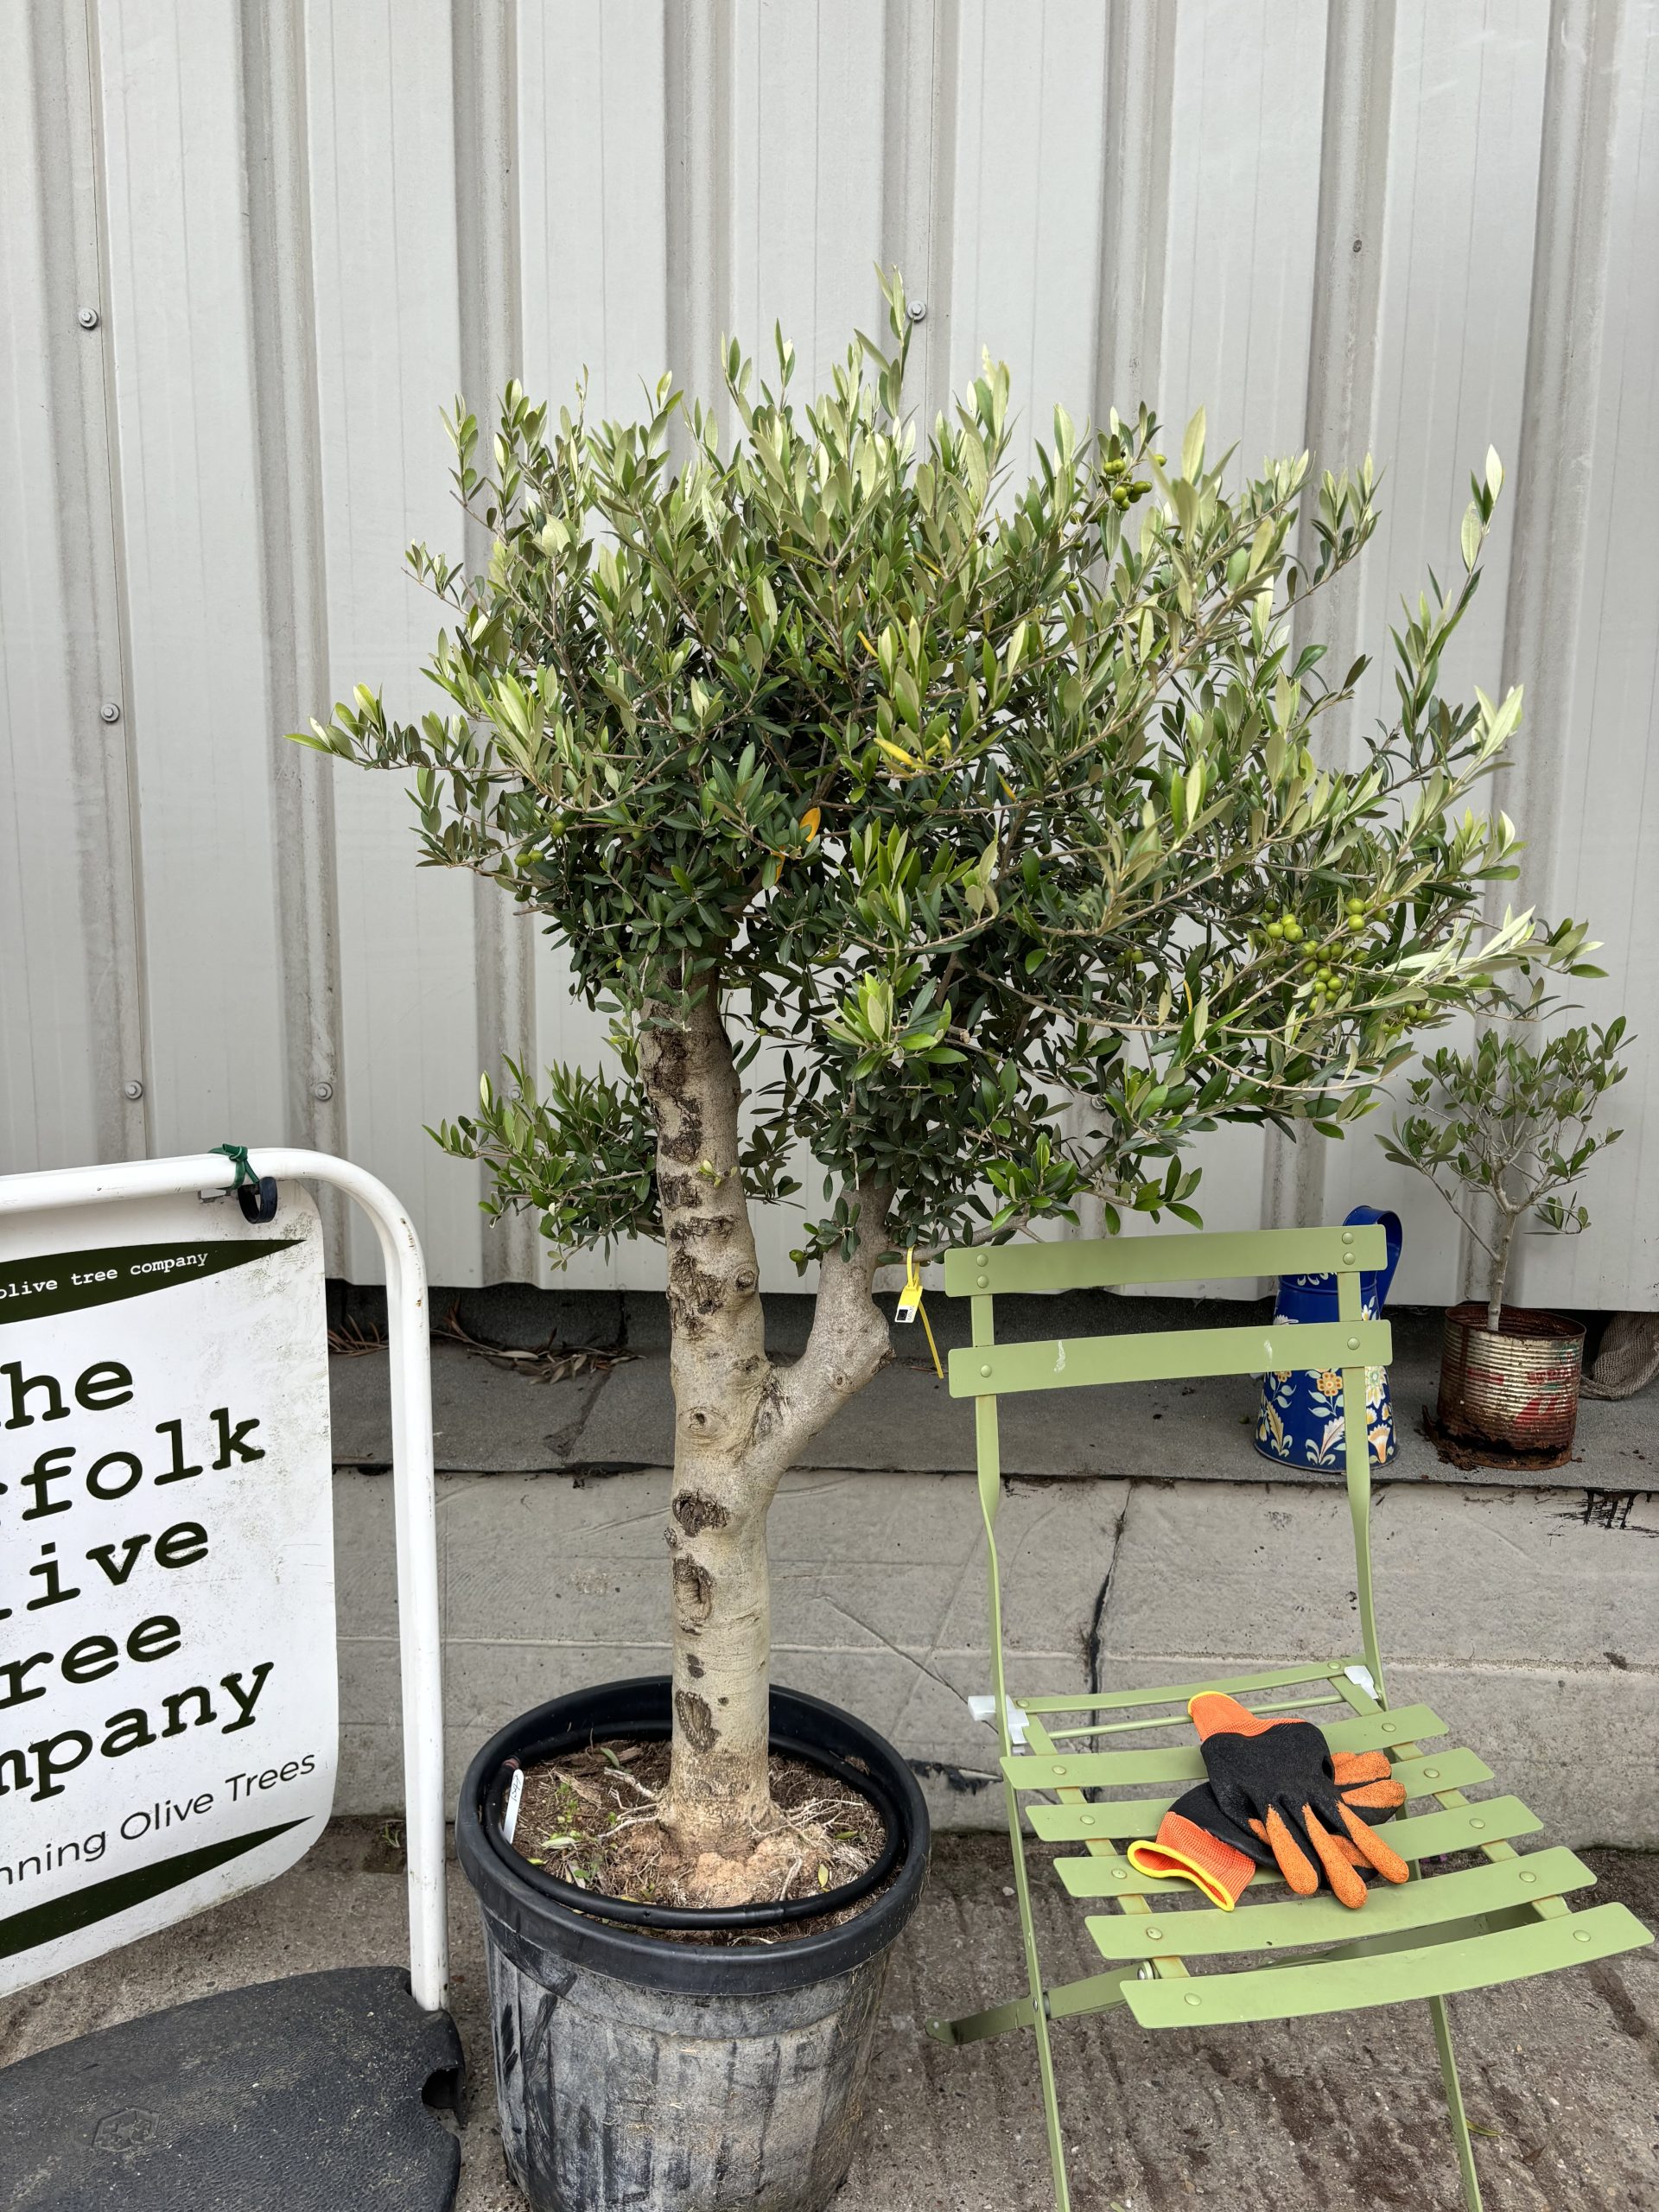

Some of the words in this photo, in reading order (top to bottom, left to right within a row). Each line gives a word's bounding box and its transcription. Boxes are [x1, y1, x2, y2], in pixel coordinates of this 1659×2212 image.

[71, 1268, 118, 1286] tree
[130, 1253, 208, 1276] company
[0, 1360, 134, 1429] he
[0, 1408, 265, 1521] folk
[0, 1522, 208, 1620] ive
[120, 1793, 214, 1840] Olive
[225, 1754, 316, 1802] Trees
